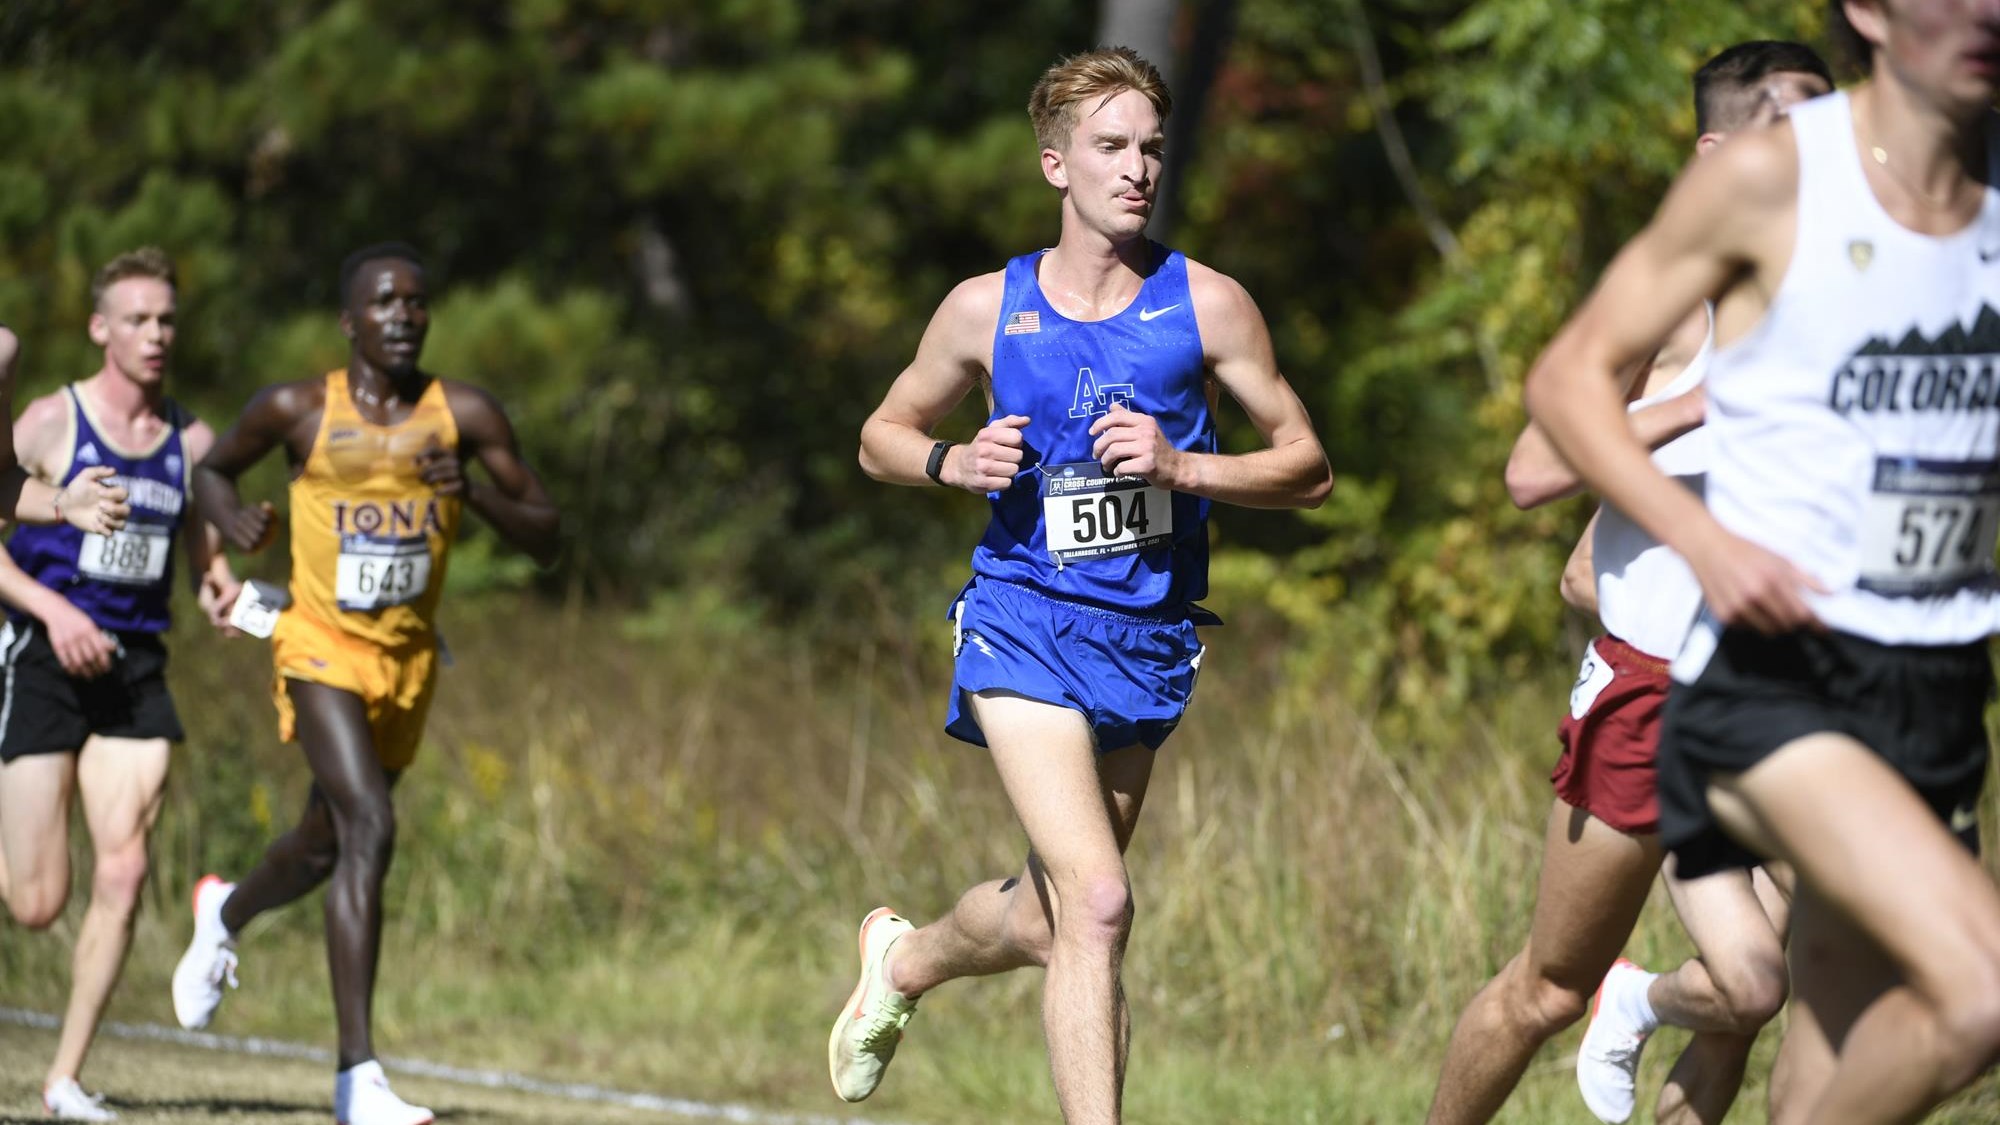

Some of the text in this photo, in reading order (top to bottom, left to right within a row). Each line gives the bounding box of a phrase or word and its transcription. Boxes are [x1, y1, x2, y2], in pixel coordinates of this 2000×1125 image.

[1830, 362, 2000, 415] COLORA
[1063, 479, 1086, 488] CROSS
[1086, 477, 1115, 487] COUNTRY
[335, 502, 442, 535] IONA
[1072, 491, 1149, 543] 504
[1896, 506, 1983, 568] 574
[100, 536, 151, 576] 889
[358, 561, 414, 594] 643
